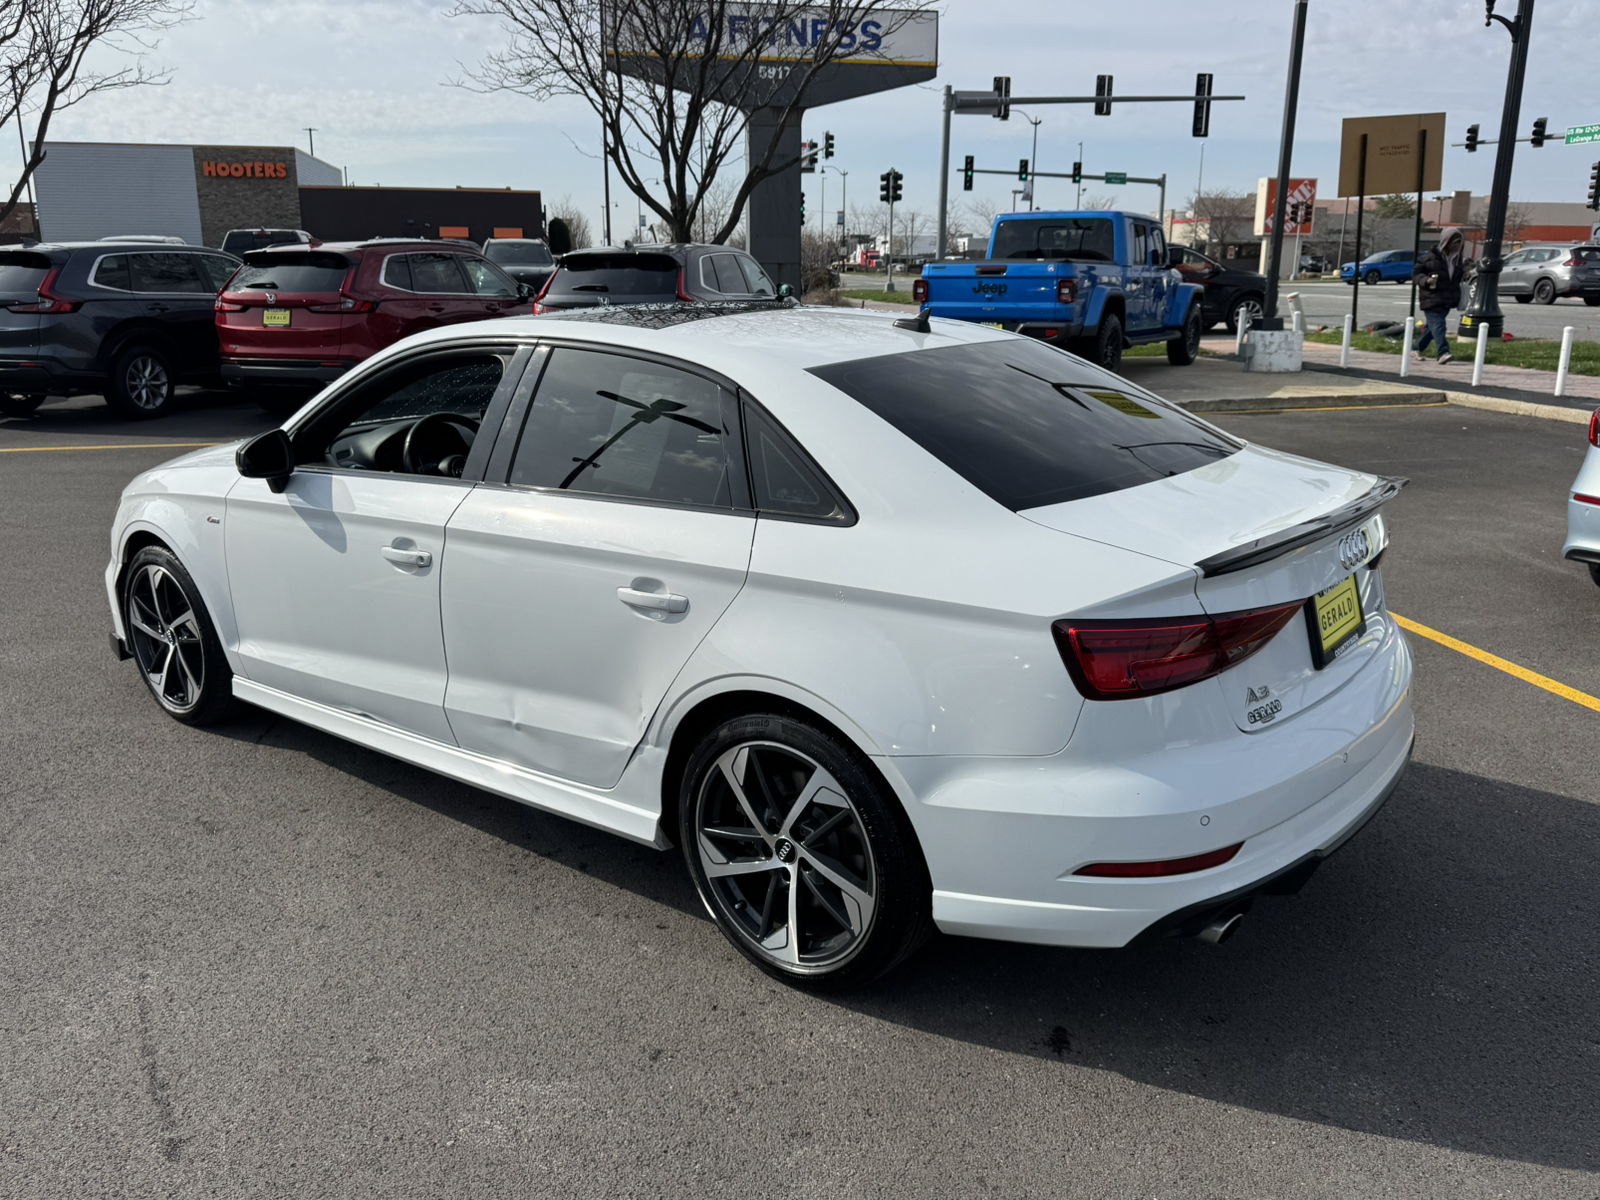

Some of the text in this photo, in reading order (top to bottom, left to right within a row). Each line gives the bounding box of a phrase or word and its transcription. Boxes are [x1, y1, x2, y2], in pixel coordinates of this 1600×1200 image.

[203, 161, 287, 178] HOOTERS
[972, 280, 1008, 296] Jeep
[1320, 597, 1353, 631] GERALD
[1334, 632, 1359, 657] COUNTRYSIDE
[1245, 685, 1270, 708] A3
[1247, 699, 1282, 724] GERALD
